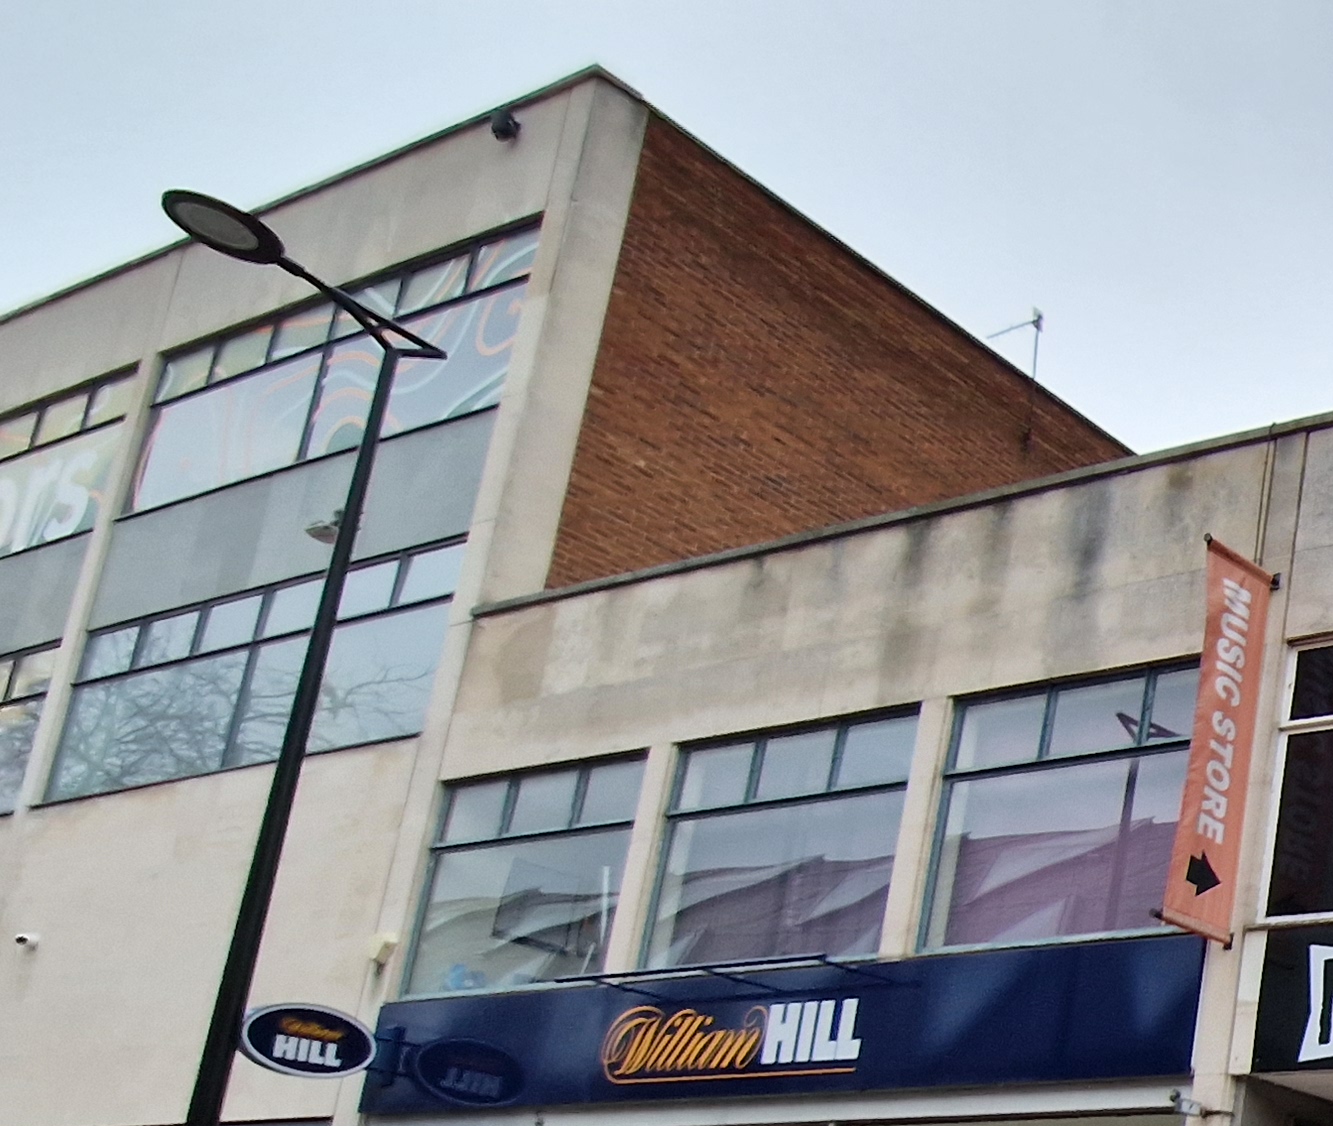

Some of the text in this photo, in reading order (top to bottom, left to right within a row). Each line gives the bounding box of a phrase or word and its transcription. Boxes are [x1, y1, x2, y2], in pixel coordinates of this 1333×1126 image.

[1196, 577, 1252, 845] MUSIC STORE
[273, 1034, 341, 1067] HILL
[603, 998, 861, 1077] William HILL
